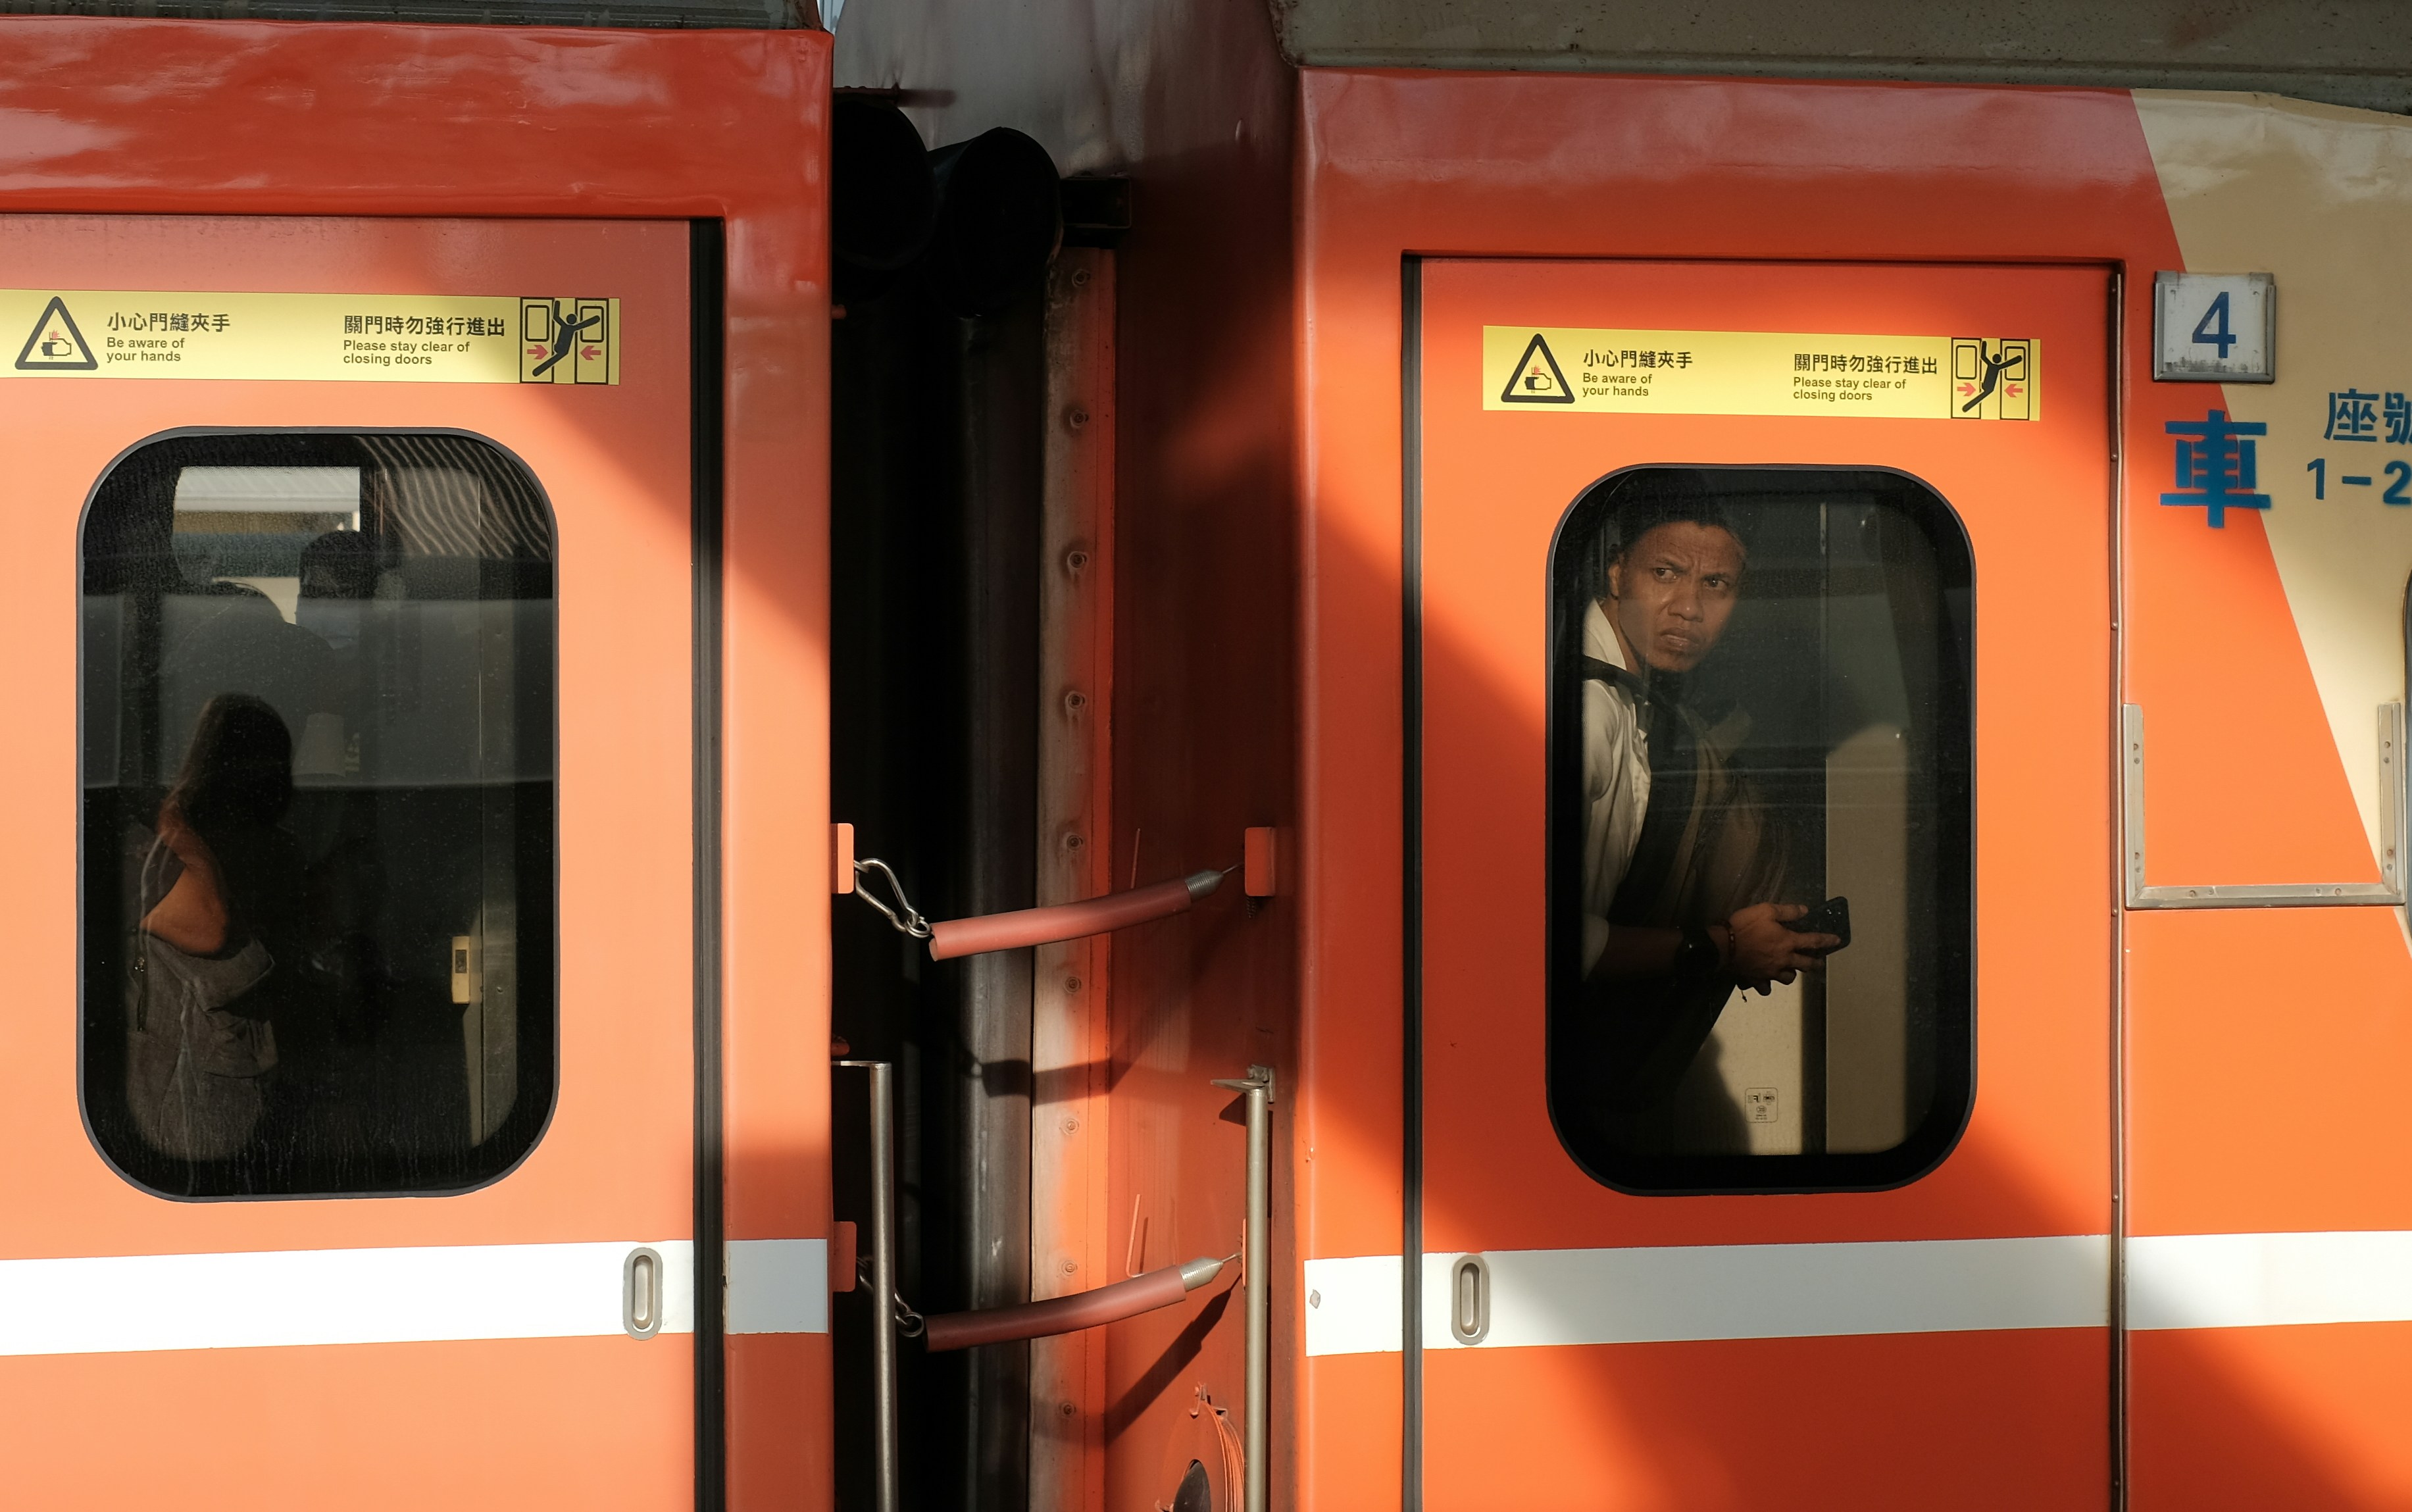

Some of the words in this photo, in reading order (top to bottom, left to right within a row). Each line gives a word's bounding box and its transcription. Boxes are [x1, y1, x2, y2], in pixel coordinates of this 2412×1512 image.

[107, 312, 230, 332] 小心門縫夾手
[343, 315, 505, 336] 關門時勿強行進出
[2192, 291, 2237, 359] 4
[107, 337, 124, 348] Be
[128, 339, 167, 348] aware
[171, 338, 185, 348] of
[343, 340, 386, 351] Please
[390, 341, 417, 354] stay
[421, 341, 453, 352] clear
[457, 341, 470, 352] of
[107, 352, 137, 363] your
[141, 351, 181, 361] hands
[343, 353, 391, 366] closing
[395, 353, 432, 365] doors
[1583, 349, 1693, 368] 小心門縫夾手
[1794, 353, 1937, 374] 關門時勿強行進出
[1582, 372, 1598, 383] Be
[1601, 375, 1637, 384] aware
[1640, 374, 1652, 384] of
[1793, 377, 1832, 387] Please
[1835, 378, 1859, 390] stay
[1863, 378, 1892, 389] clear
[1895, 379, 1907, 389] of
[1582, 386, 1609, 397] your
[1613, 386, 1649, 396] hands
[1793, 390, 1836, 402] closing
[1839, 390, 1872, 401] doors
[2159, 409, 2272, 529] 車
